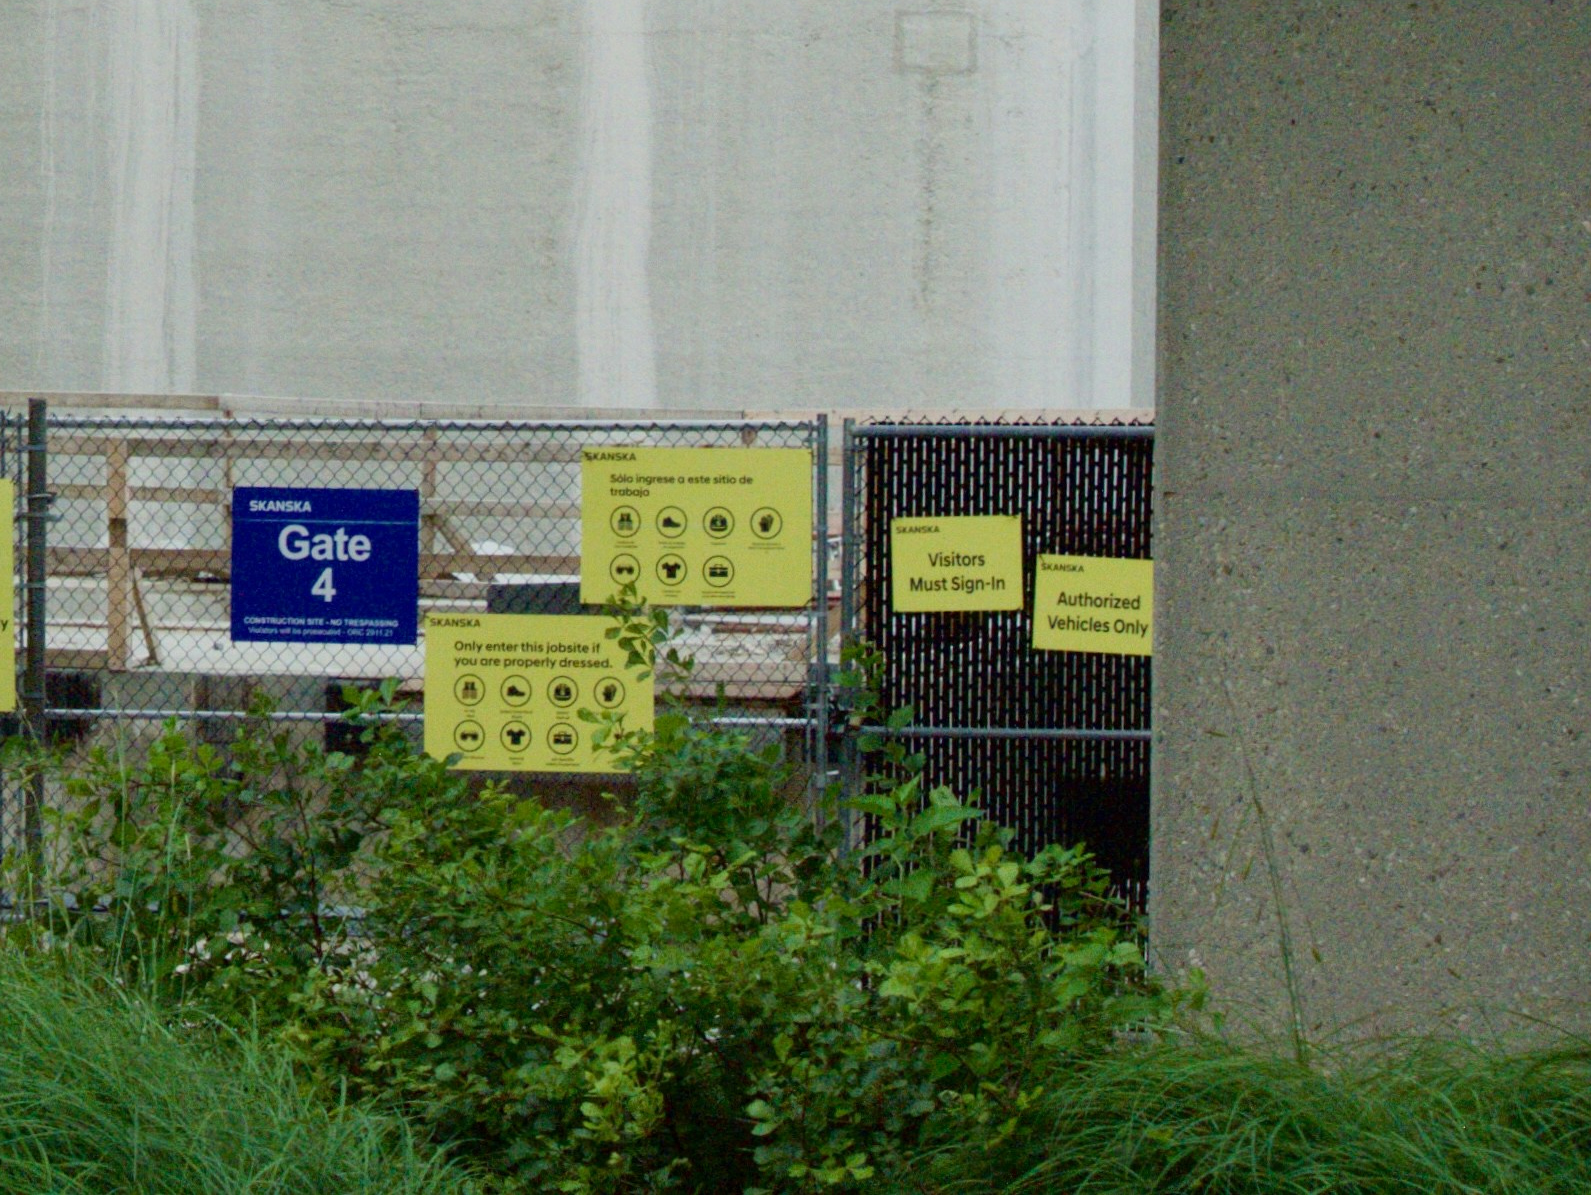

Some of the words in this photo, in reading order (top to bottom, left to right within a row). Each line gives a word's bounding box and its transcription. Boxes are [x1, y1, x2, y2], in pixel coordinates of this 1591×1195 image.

[586, 453, 636, 461] SKANSKA
[610, 474, 633, 484] Sólo
[636, 474, 675, 486] ingrese
[687, 476, 710, 484] este
[713, 474, 736, 484] sitio
[739, 475, 753, 485] de
[610, 487, 650, 498] trabajo
[249, 500, 312, 512] SKANSKA
[896, 526, 940, 534] SKANSKA
[278, 524, 372, 561] Gate
[928, 552, 986, 567] Visitors
[1041, 563, 1085, 573] SKANSKA
[311, 567, 337, 602] 4
[909, 576, 948, 592] Must
[951, 576, 1006, 594] Sign-In
[1057, 591, 1141, 610] Authorized
[243, 617, 305, 625] CONSTRUCTION
[307, 617, 324, 626] SITE
[429, 618, 481, 628] SKANSKA
[1047, 615, 1110, 633] Vehicles
[1113, 619, 1149, 638] Only
[454, 641, 482, 653] Only
[485, 642, 518, 652] enter
[521, 642, 544, 653] this
[546, 642, 589, 654] jobsite
[592, 643, 601, 653] if
[454, 657, 477, 667] you
[480, 658, 501, 667] are
[504, 657, 557, 669] properly
[559, 657, 613, 669] dressed.
